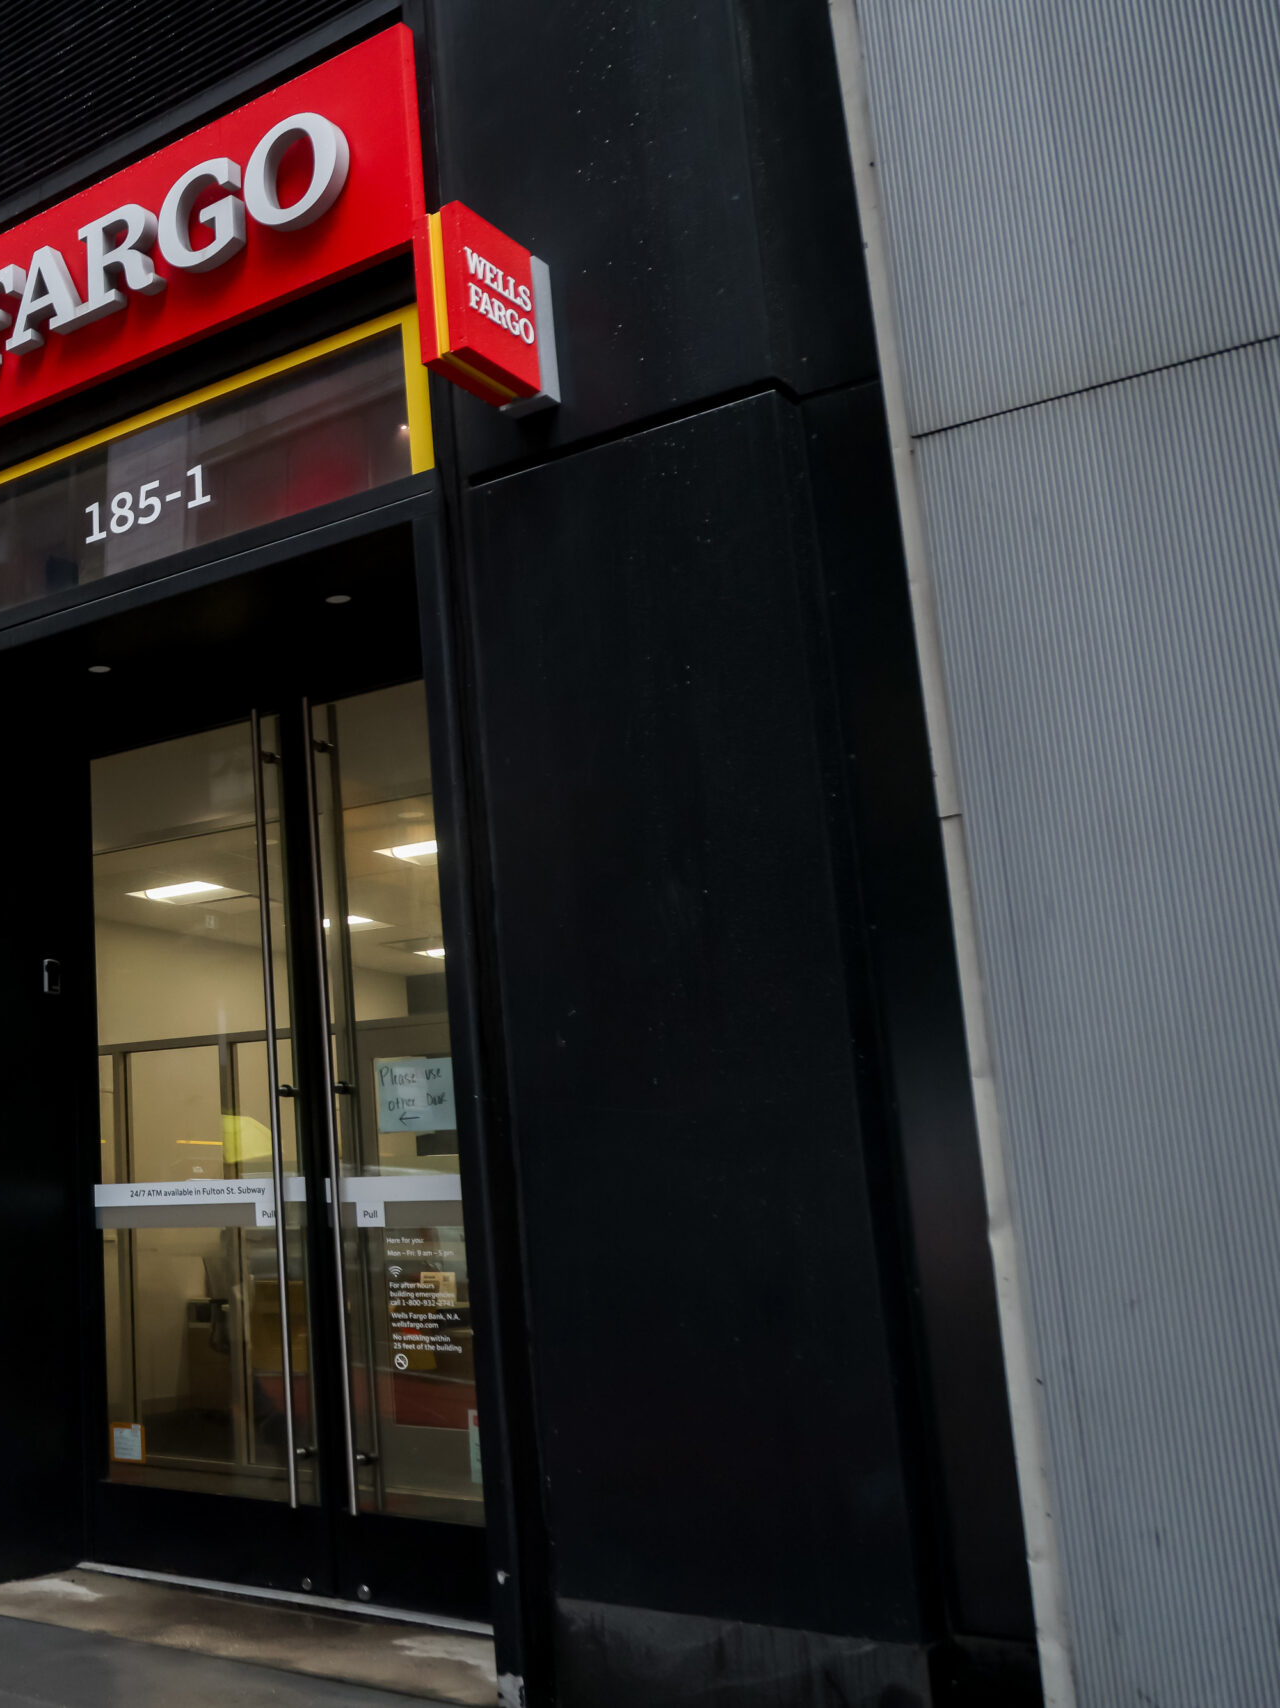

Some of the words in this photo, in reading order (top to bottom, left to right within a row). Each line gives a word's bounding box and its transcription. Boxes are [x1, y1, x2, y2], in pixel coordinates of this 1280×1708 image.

[463, 246, 532, 312] WELLS
[467, 282, 535, 344] FARGO
[85, 464, 212, 545] 185-1
[130, 1190, 146, 1198] 24/7
[147, 1189, 163, 1197] ATM
[164, 1188, 193, 1197] available
[194, 1188, 201, 1196] in
[203, 1187, 225, 1196] Fulton
[226, 1187, 237, 1195] St.
[238, 1186, 266, 1196] Subway
[364, 1210, 378, 1219] Pull
[390, 1291, 415, 1299] building
[409, 1313, 427, 1321] Fargo
[392, 1321, 439, 1329] wellsfargo.com
[403, 1334, 430, 1343] smoking
[436, 1344, 462, 1353] building
